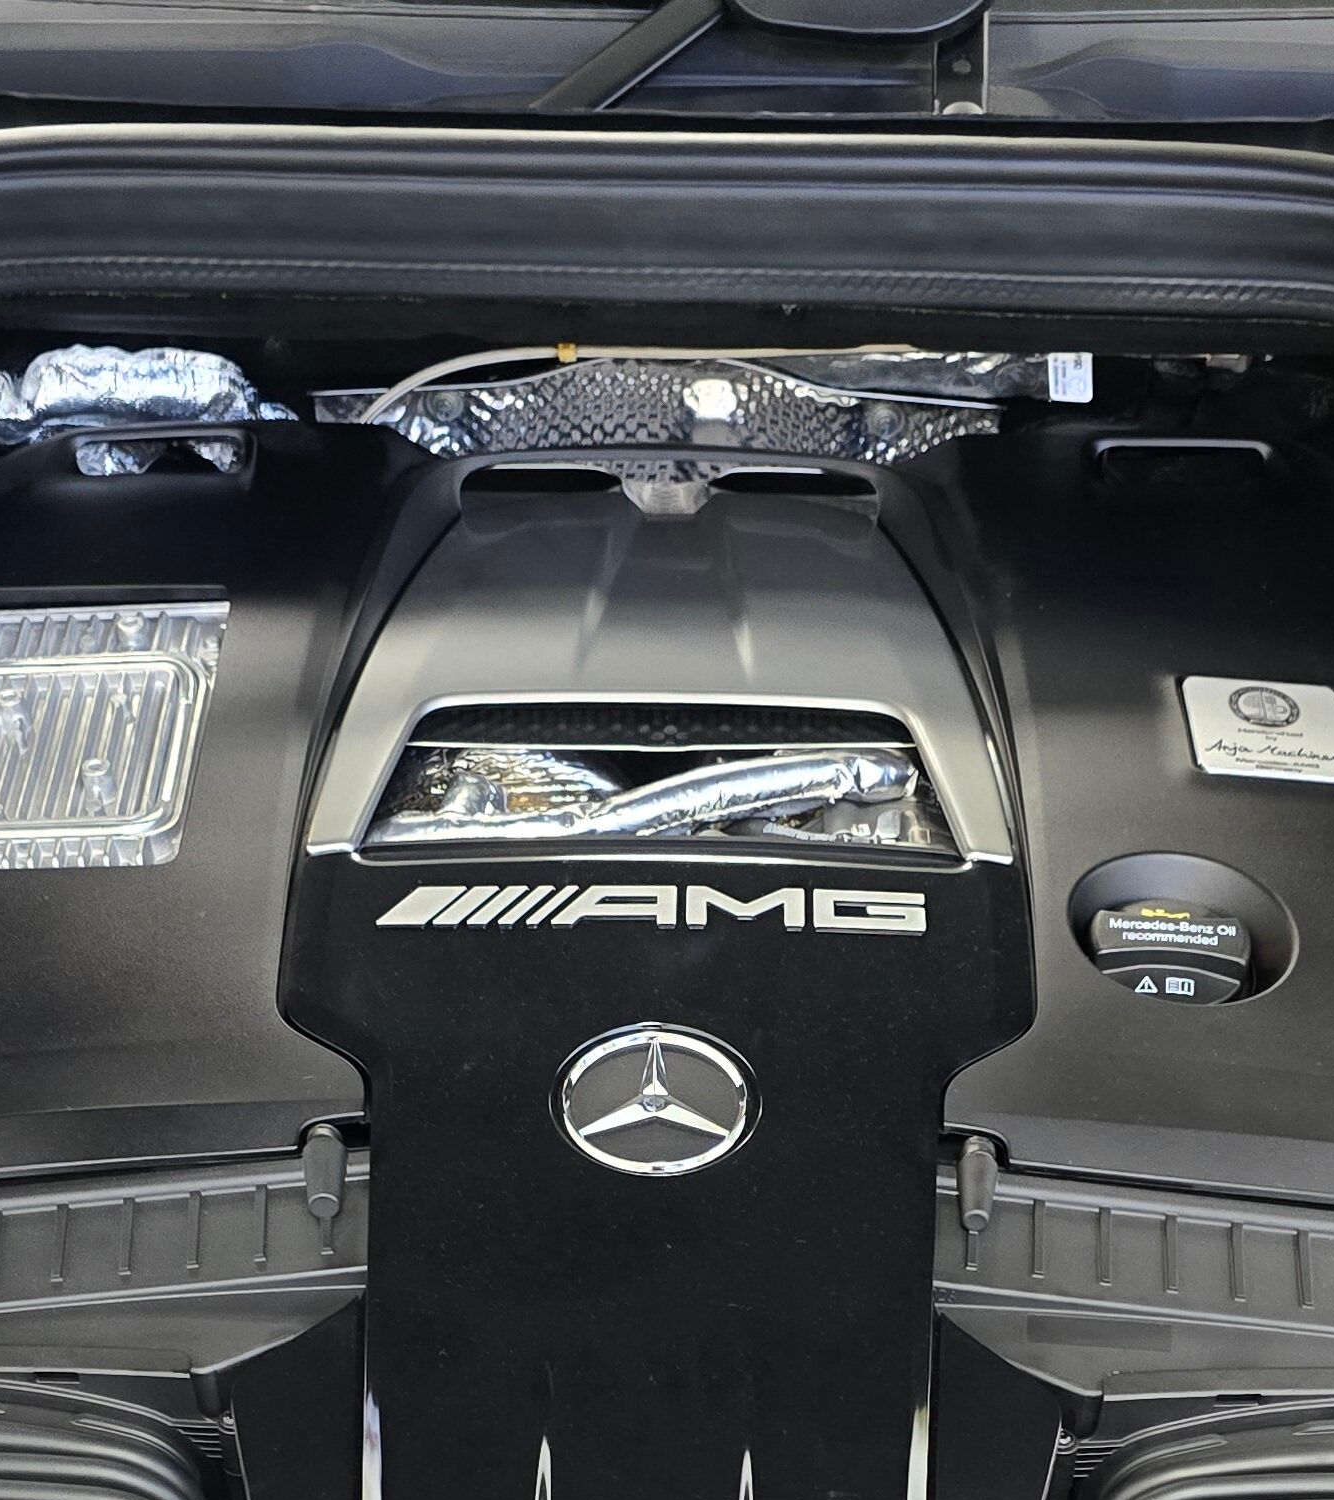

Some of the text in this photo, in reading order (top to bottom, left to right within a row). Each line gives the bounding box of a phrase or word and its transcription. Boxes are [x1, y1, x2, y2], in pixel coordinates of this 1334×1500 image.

[551, 885, 928, 936] AMG
[1109, 918, 1237, 937] Mercedes-Benz Oil
[1122, 931, 1219, 946] recommended
